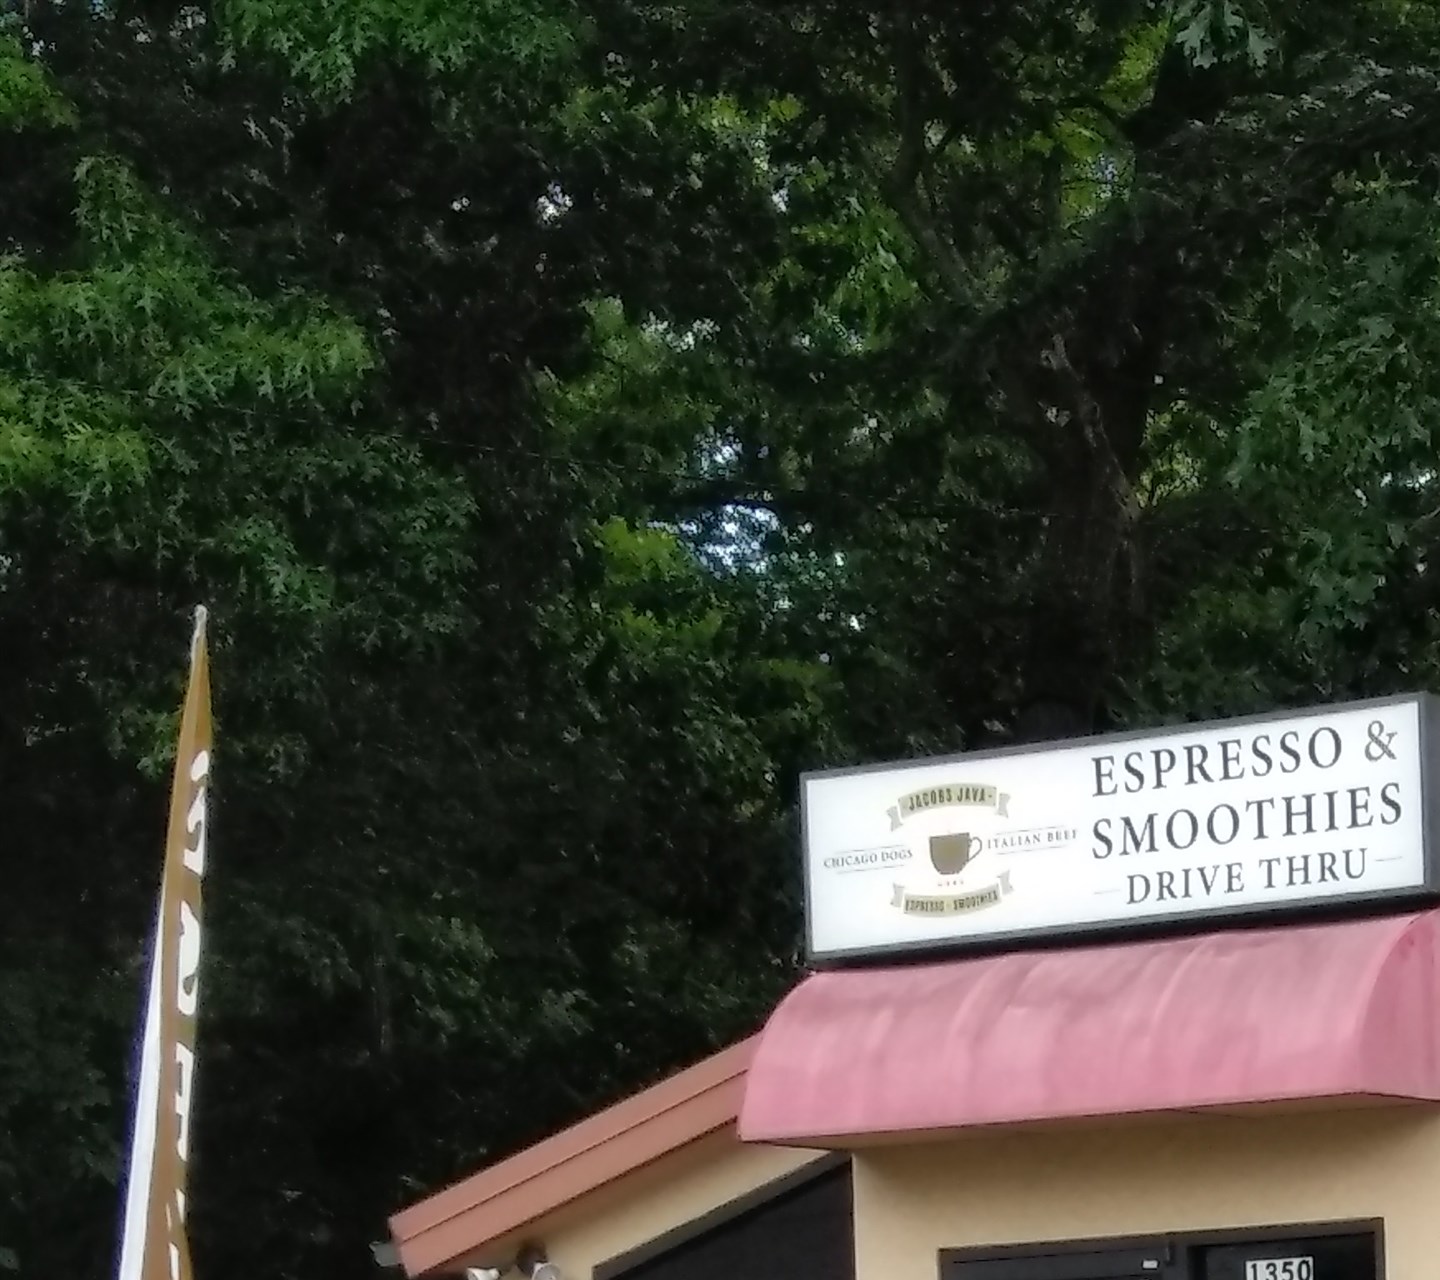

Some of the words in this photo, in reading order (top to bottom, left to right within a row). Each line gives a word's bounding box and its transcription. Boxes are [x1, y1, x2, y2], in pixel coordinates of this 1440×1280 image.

[1090, 726, 1343, 798] ESPRESSO
[1363, 719, 1399, 762] &
[908, 788, 953, 812] JACOBS
[956, 787, 987, 802] JAVA
[986, 832, 1042, 850] ITALIAN
[1046, 828, 1079, 843] BEEF
[1091, 782, 1403, 860] SMOOTHIES
[823, 851, 878, 869] CHICAGO
[881, 848, 913, 862] DOGS
[1126, 861, 1246, 905] DRIVE
[1258, 847, 1369, 890] THRU
